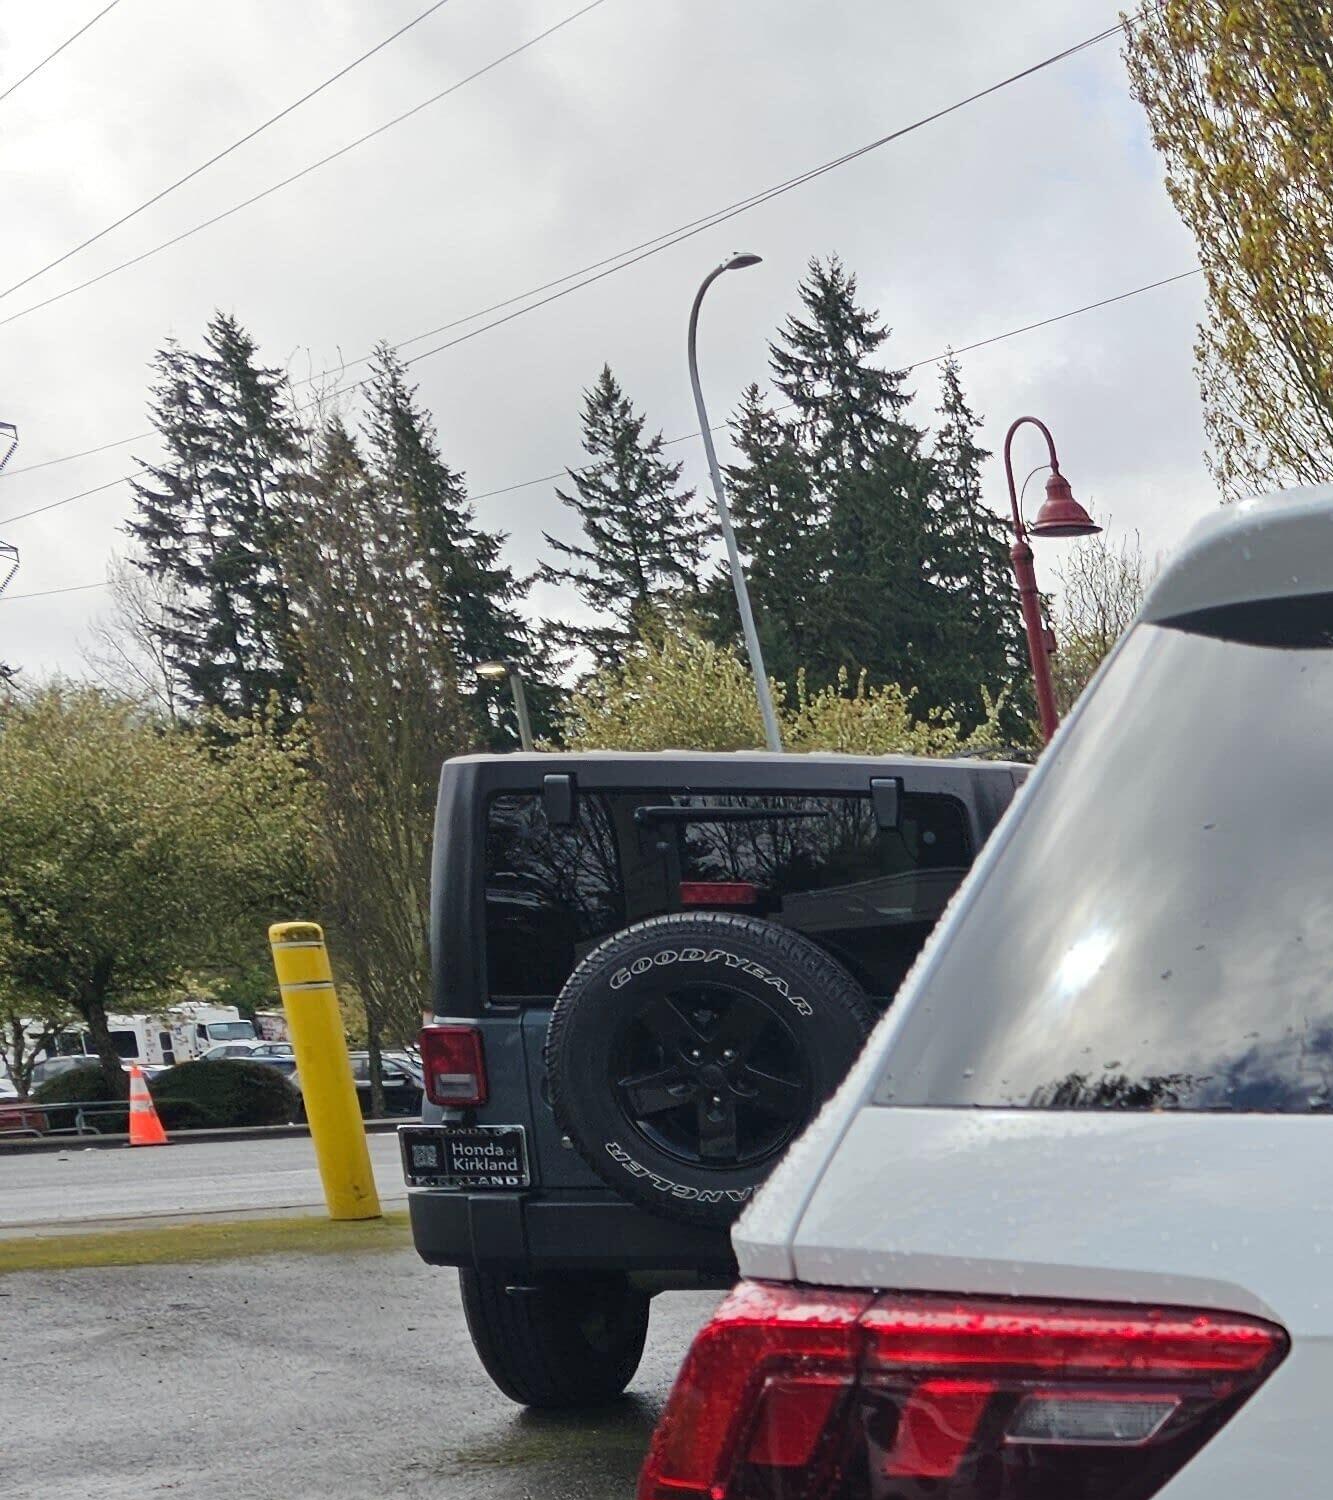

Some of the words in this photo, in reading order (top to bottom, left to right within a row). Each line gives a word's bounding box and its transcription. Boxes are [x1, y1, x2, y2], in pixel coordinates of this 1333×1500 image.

[609, 948, 813, 1016] GOODYEAR
[451, 1142, 504, 1156] Honda
[453, 1158, 518, 1171] Kirkland
[605, 1142, 764, 1202] ANGLER
